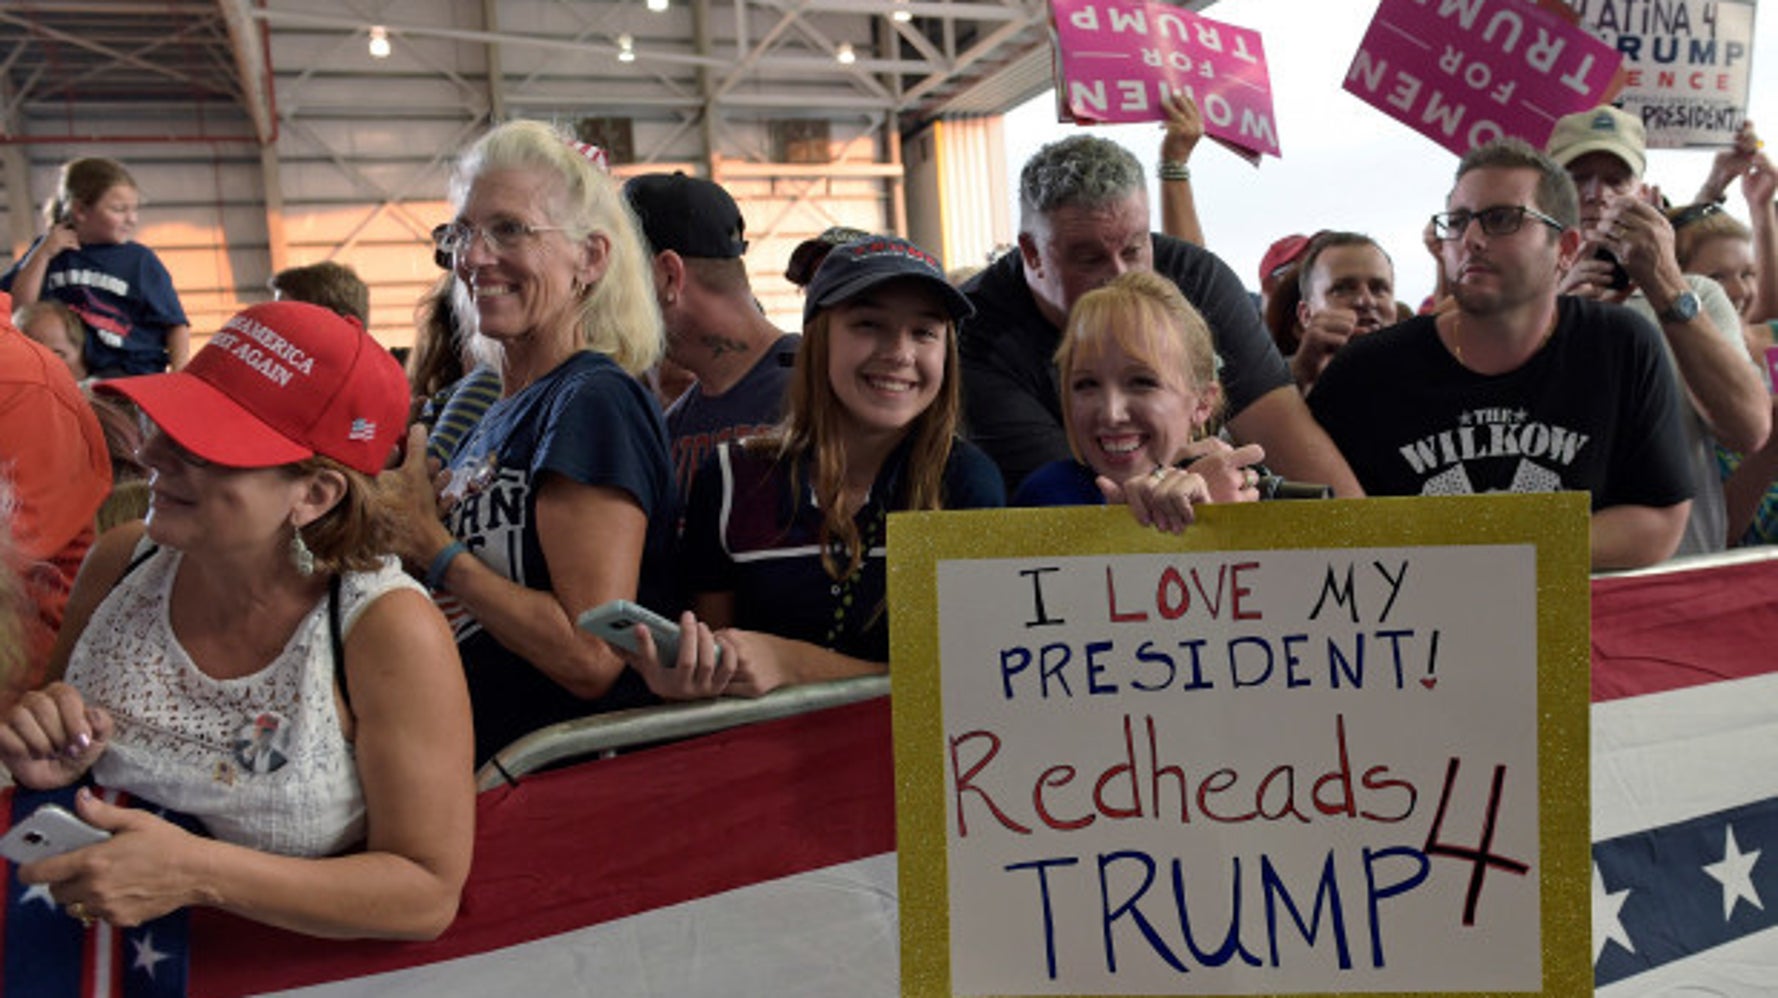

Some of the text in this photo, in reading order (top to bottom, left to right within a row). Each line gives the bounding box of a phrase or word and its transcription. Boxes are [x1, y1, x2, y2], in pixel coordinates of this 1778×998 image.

[1069, 5, 1258, 64] TRUMP
[1418, 0, 1596, 96] TRUM
[1702, 0, 1719, 39] 4
[1141, 47, 1215, 79] FOR
[1438, 45, 1517, 105] FOR
[1617, 35, 1744, 67] RUMP
[1627, 70, 1731, 90] ENCE
[1350, 50, 1505, 149] OMEN
[231, 343, 294, 388] AGAIN
[1473, 408, 1513, 424] THE
[1399, 422, 1590, 475] WILKOW
[1019, 559, 1409, 628] I LOVE MY
[1000, 629, 1441, 699] PRESIDENT!
[948, 713, 1530, 928] Redheads 4
[1003, 845, 1432, 981] TRUMP
